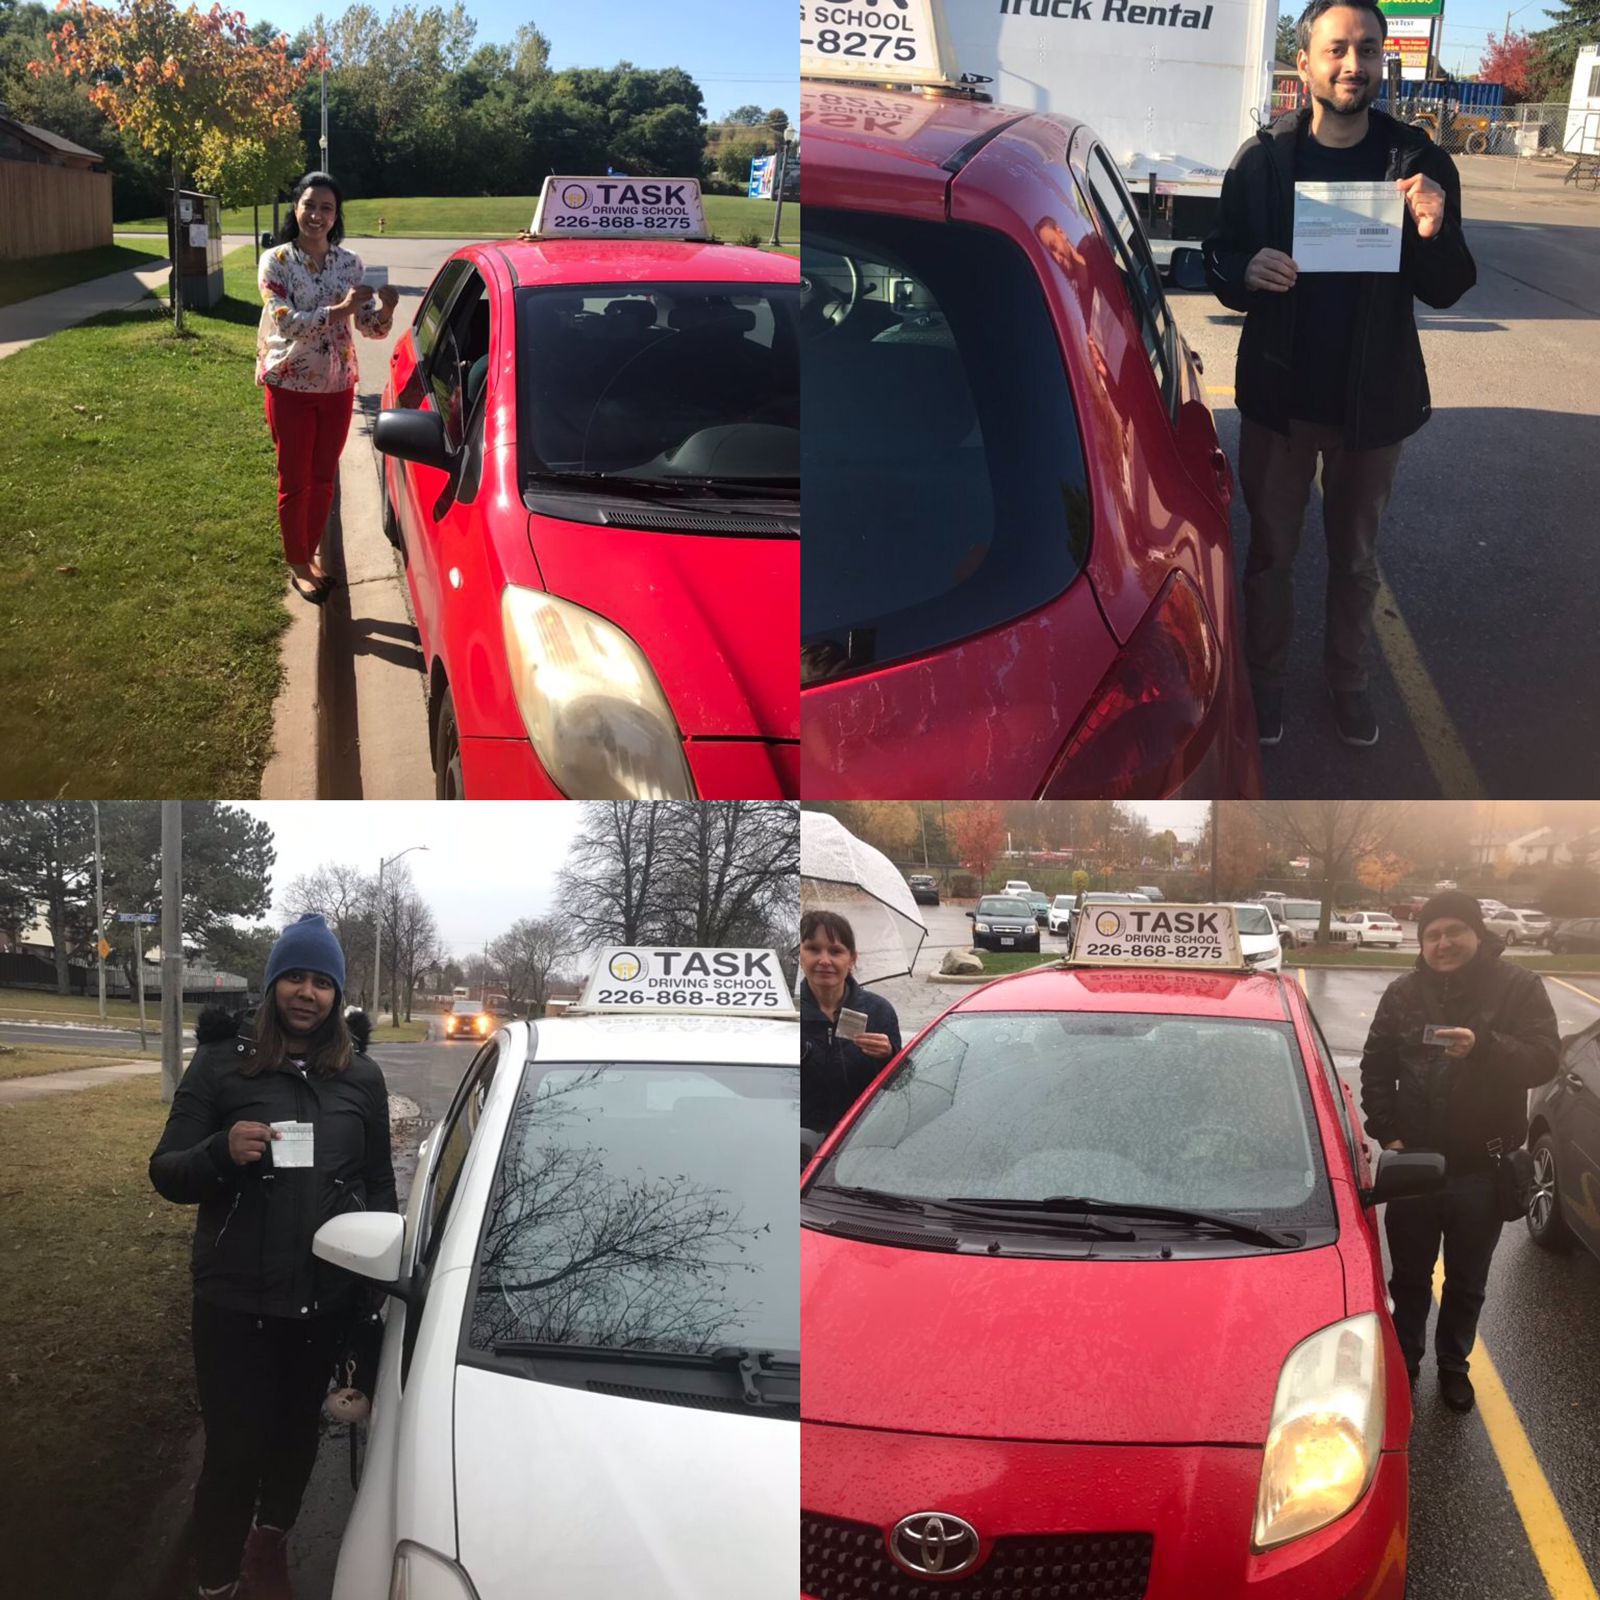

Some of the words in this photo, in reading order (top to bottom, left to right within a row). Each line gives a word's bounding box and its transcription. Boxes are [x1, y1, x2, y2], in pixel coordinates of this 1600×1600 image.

[815, 6, 914, 32] SCHOOL
[1102, 0, 1213, 30] Rental
[800, 29, 916, 61] -8275
[596, 184, 686, 206] TASK
[592, 206, 639, 215] DRIVING
[642, 206, 689, 216] SCHOOL
[554, 215, 691, 229] 226-868-8275
[1129, 911, 1219, 935] TASK
[1125, 934, 1171, 944] DRIVING
[1174, 935, 1221, 945] SCHOOL
[1086, 943, 1222, 959] 226-868-8275
[653, 951, 772, 978] TASK
[648, 977, 709, 989] DRIVING
[713, 978, 777, 990] SCHOOL
[598, 989, 779, 1007] 226-868-8275
